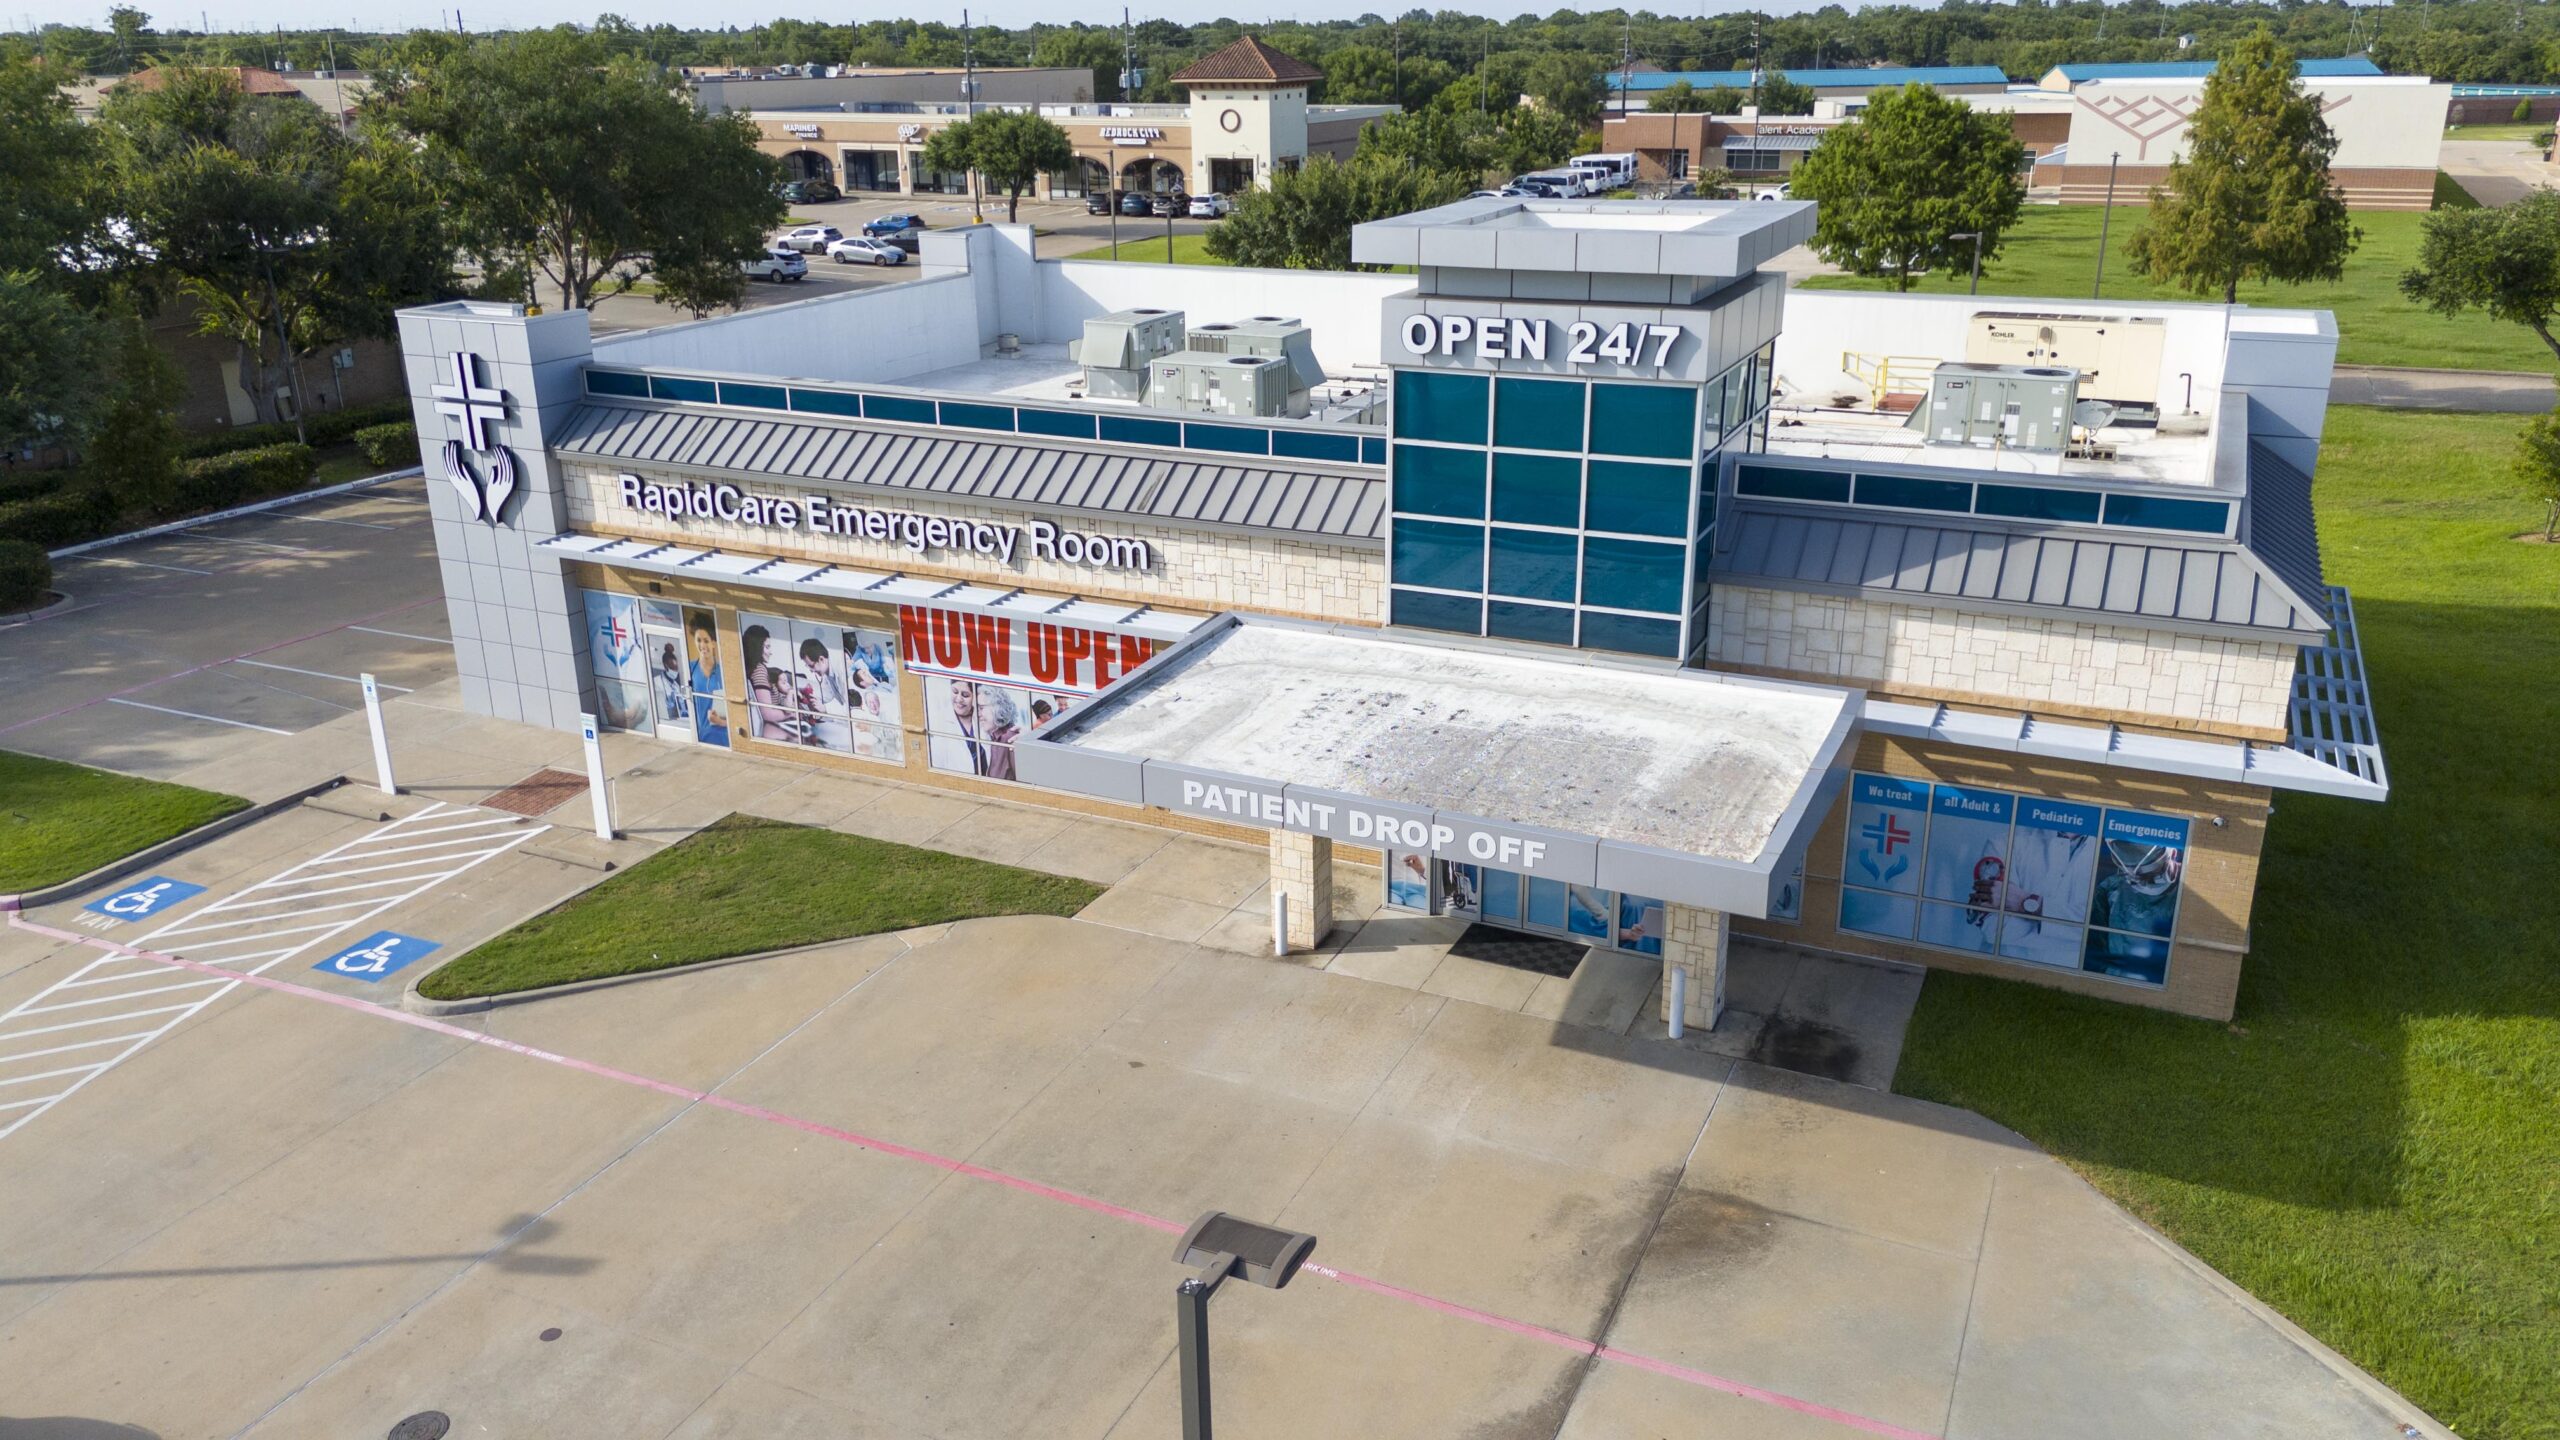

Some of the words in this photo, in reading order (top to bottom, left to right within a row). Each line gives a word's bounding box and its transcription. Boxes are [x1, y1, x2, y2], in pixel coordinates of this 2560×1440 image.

[783, 124, 817, 132] MARINER
[1786, 125, 1826, 134] Academ
[1401, 314, 1549, 361] OPEN
[1565, 321, 1682, 367] 24/7
[618, 474, 798, 530] RapidCare
[806, 495, 1019, 565] Emergency
[1030, 520, 1150, 570] Room
[899, 604, 1011, 676] NOW
[1027, 621, 1153, 690] OPEN
[1183, 780, 1336, 832] PATIENT
[1349, 810, 1455, 852] DROP
[1468, 831, 1547, 868] OFF
[1868, 785, 1883, 797] We
[1886, 788, 1913, 801] treat
[1944, 796, 1958, 808] all
[1961, 798, 1989, 813] Adult
[1993, 803, 2000, 814] &
[2032, 809, 2083, 826] Pediatric
[2108, 819, 2182, 840] Emergencies
[71, 911, 123, 930] VAN
